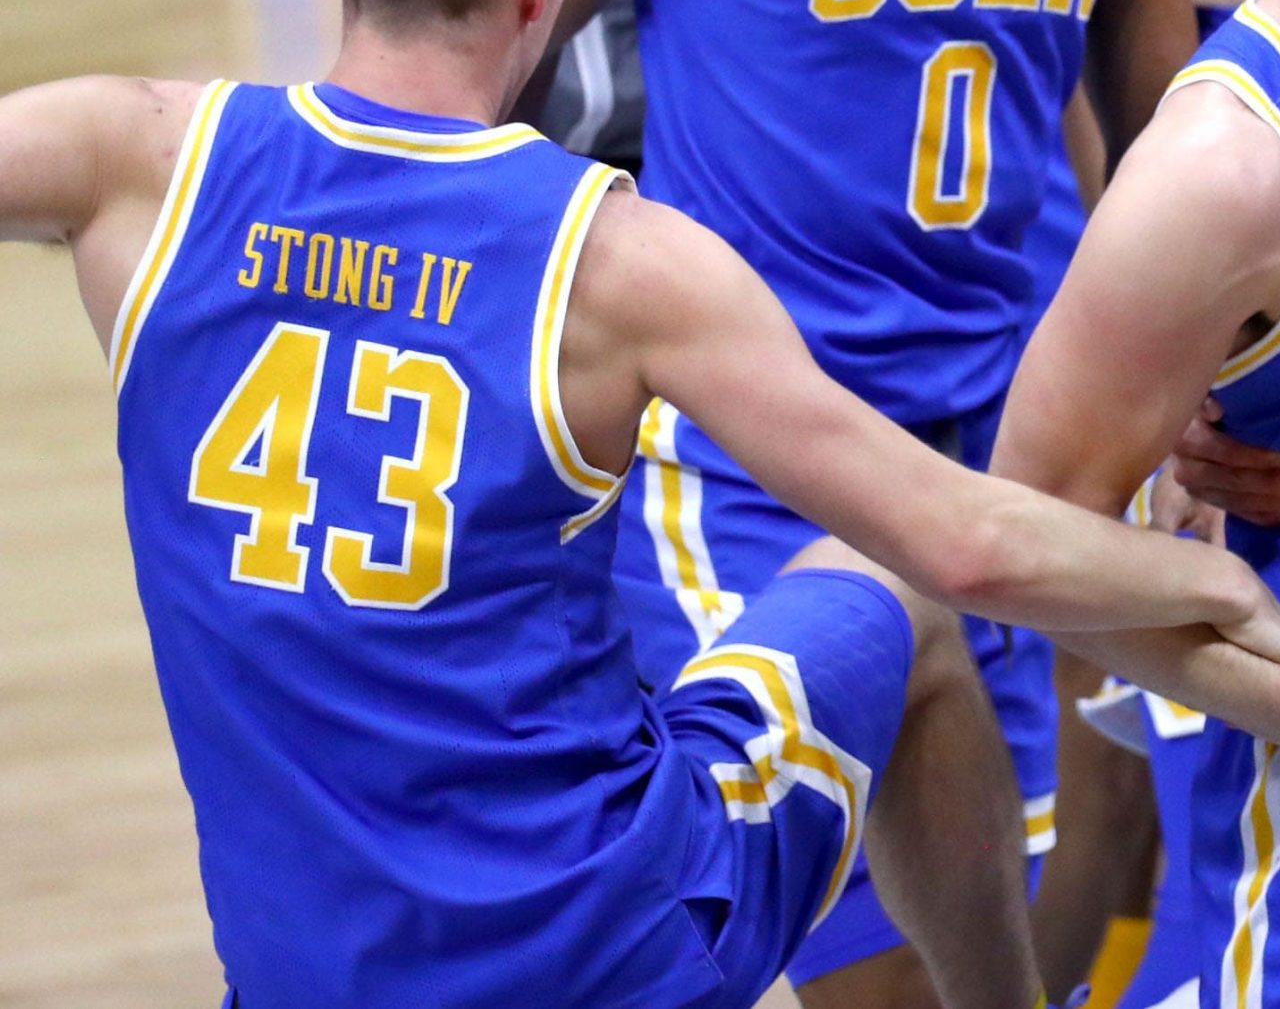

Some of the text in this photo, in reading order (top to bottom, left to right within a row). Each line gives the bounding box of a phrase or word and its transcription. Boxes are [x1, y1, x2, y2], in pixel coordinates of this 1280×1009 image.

[906, 40, 998, 231] 0
[238, 221, 473, 326] STONG IV
[187, 321, 470, 611] 43
